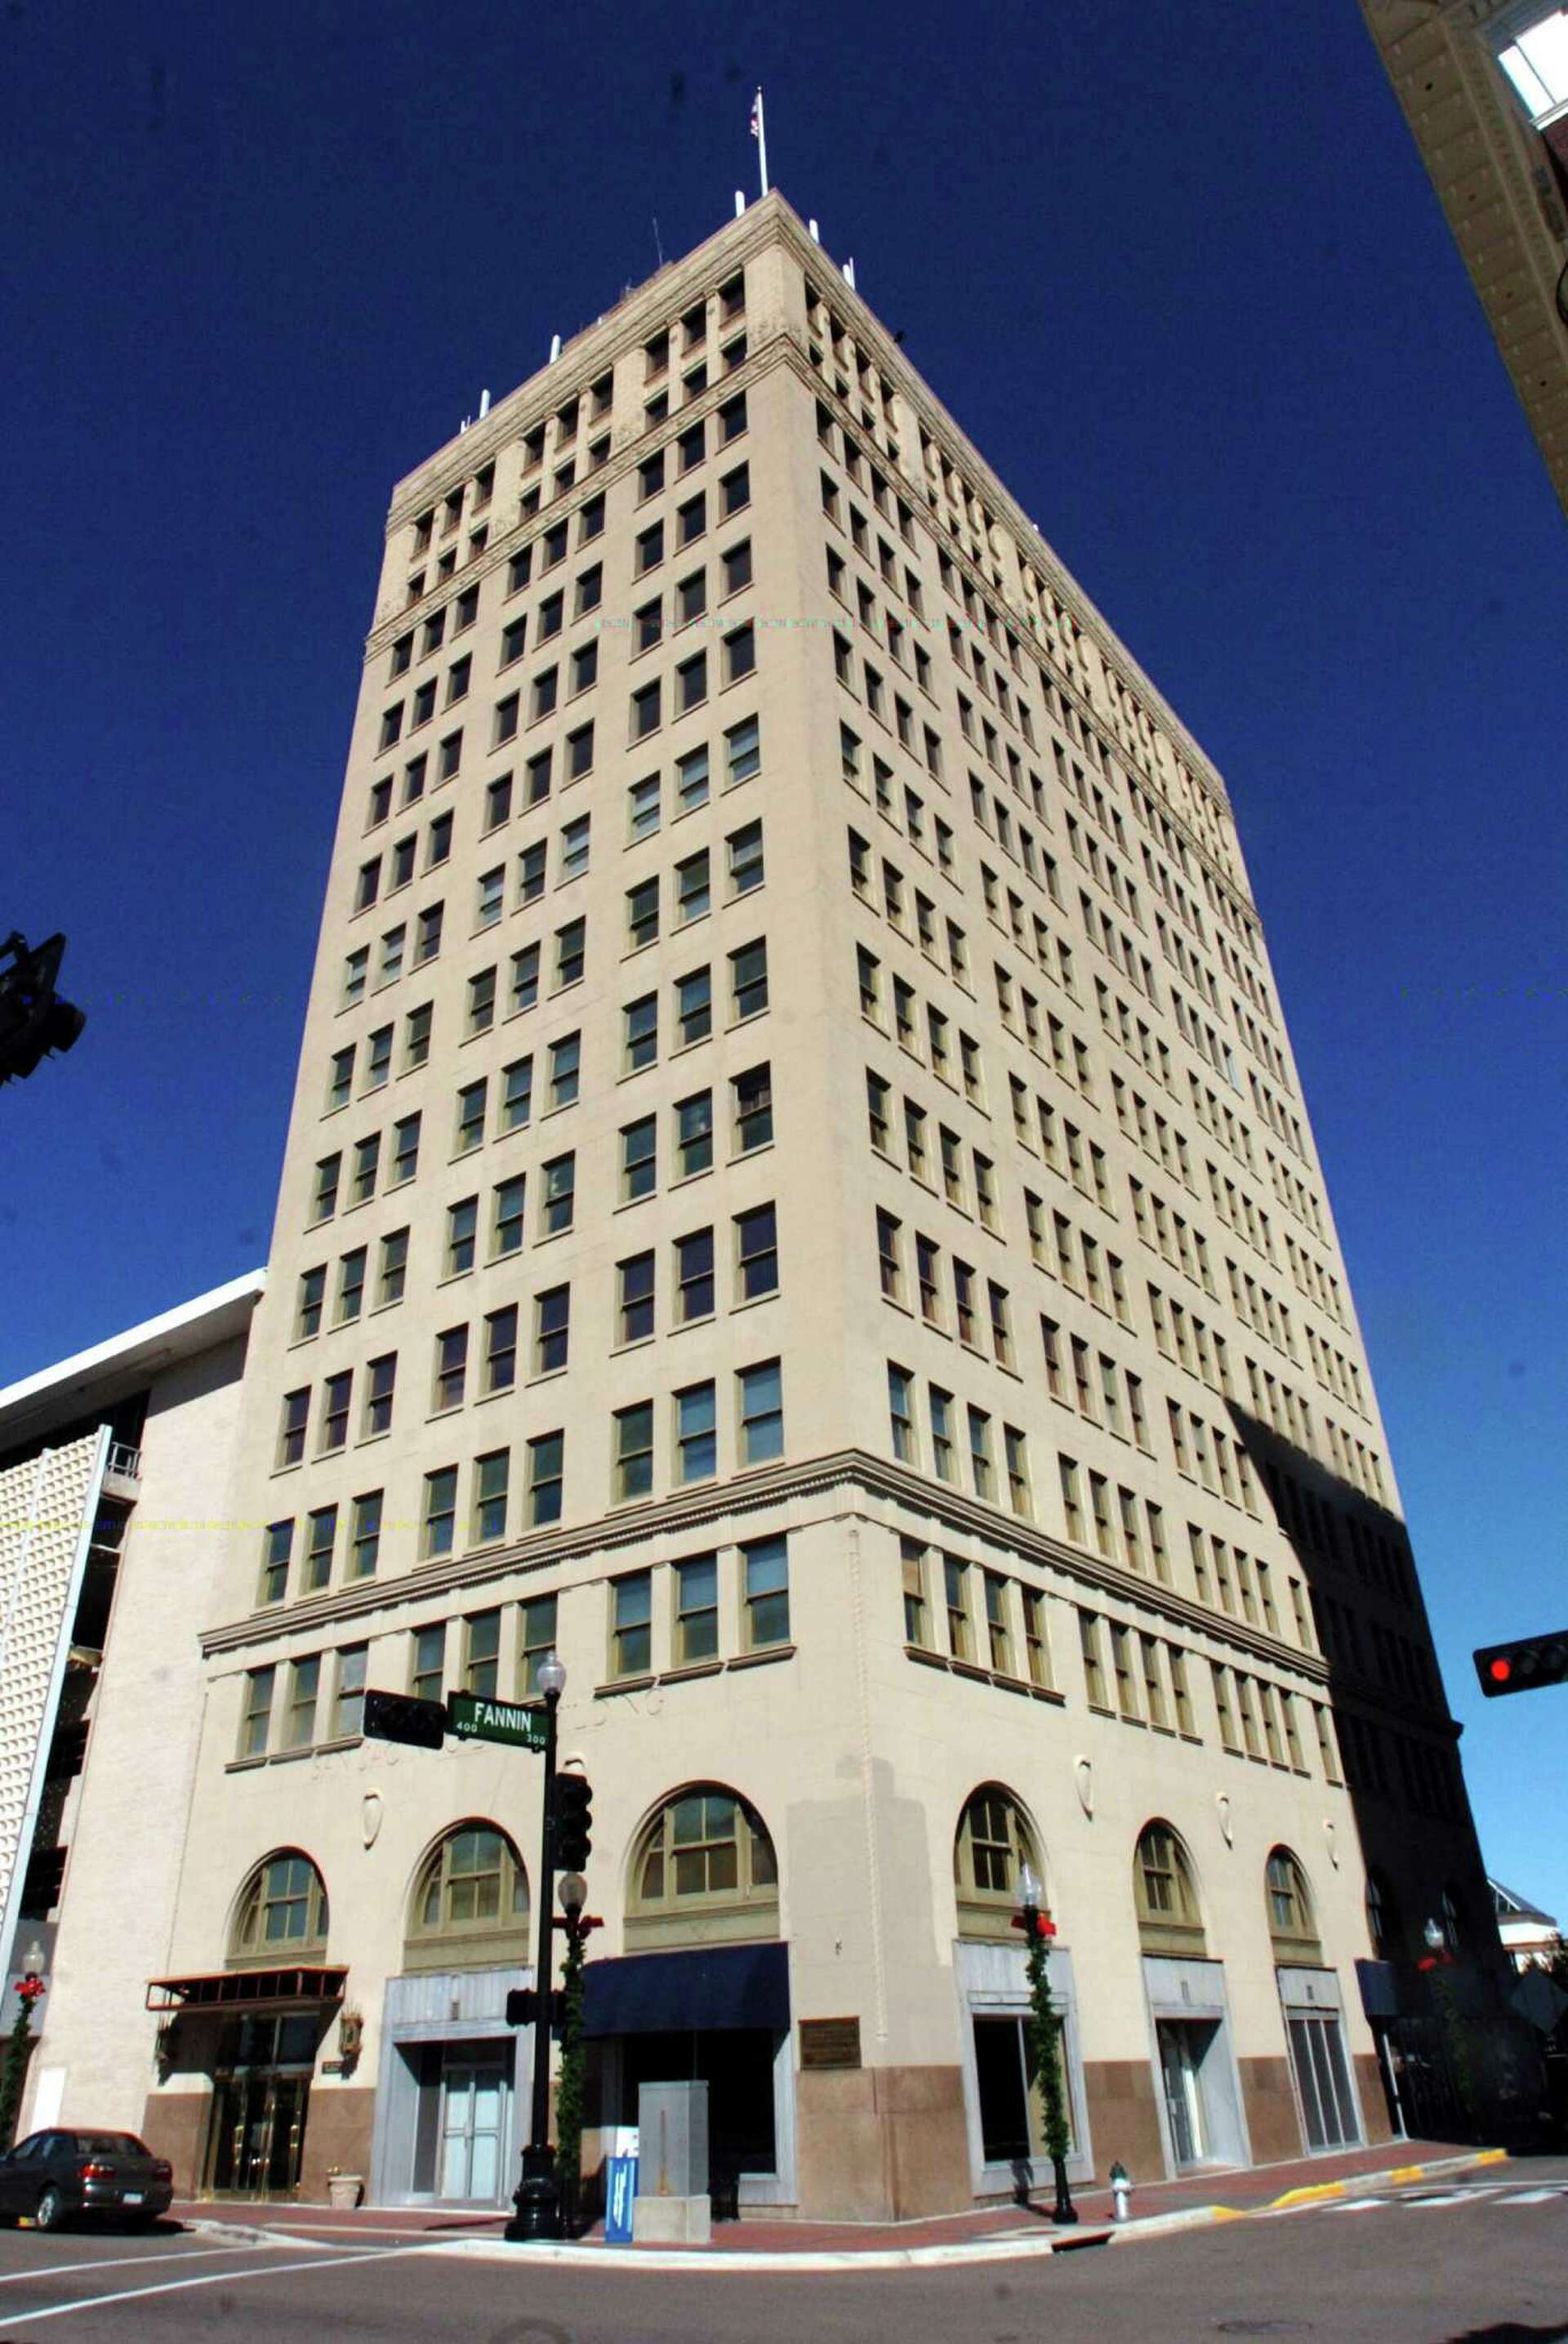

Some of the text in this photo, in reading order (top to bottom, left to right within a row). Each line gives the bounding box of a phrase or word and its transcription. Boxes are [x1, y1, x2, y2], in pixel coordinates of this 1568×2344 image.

[474, 1702, 532, 1731] FANNIN
[457, 1721, 478, 1732] 400
[526, 1733, 546, 1745] 300
